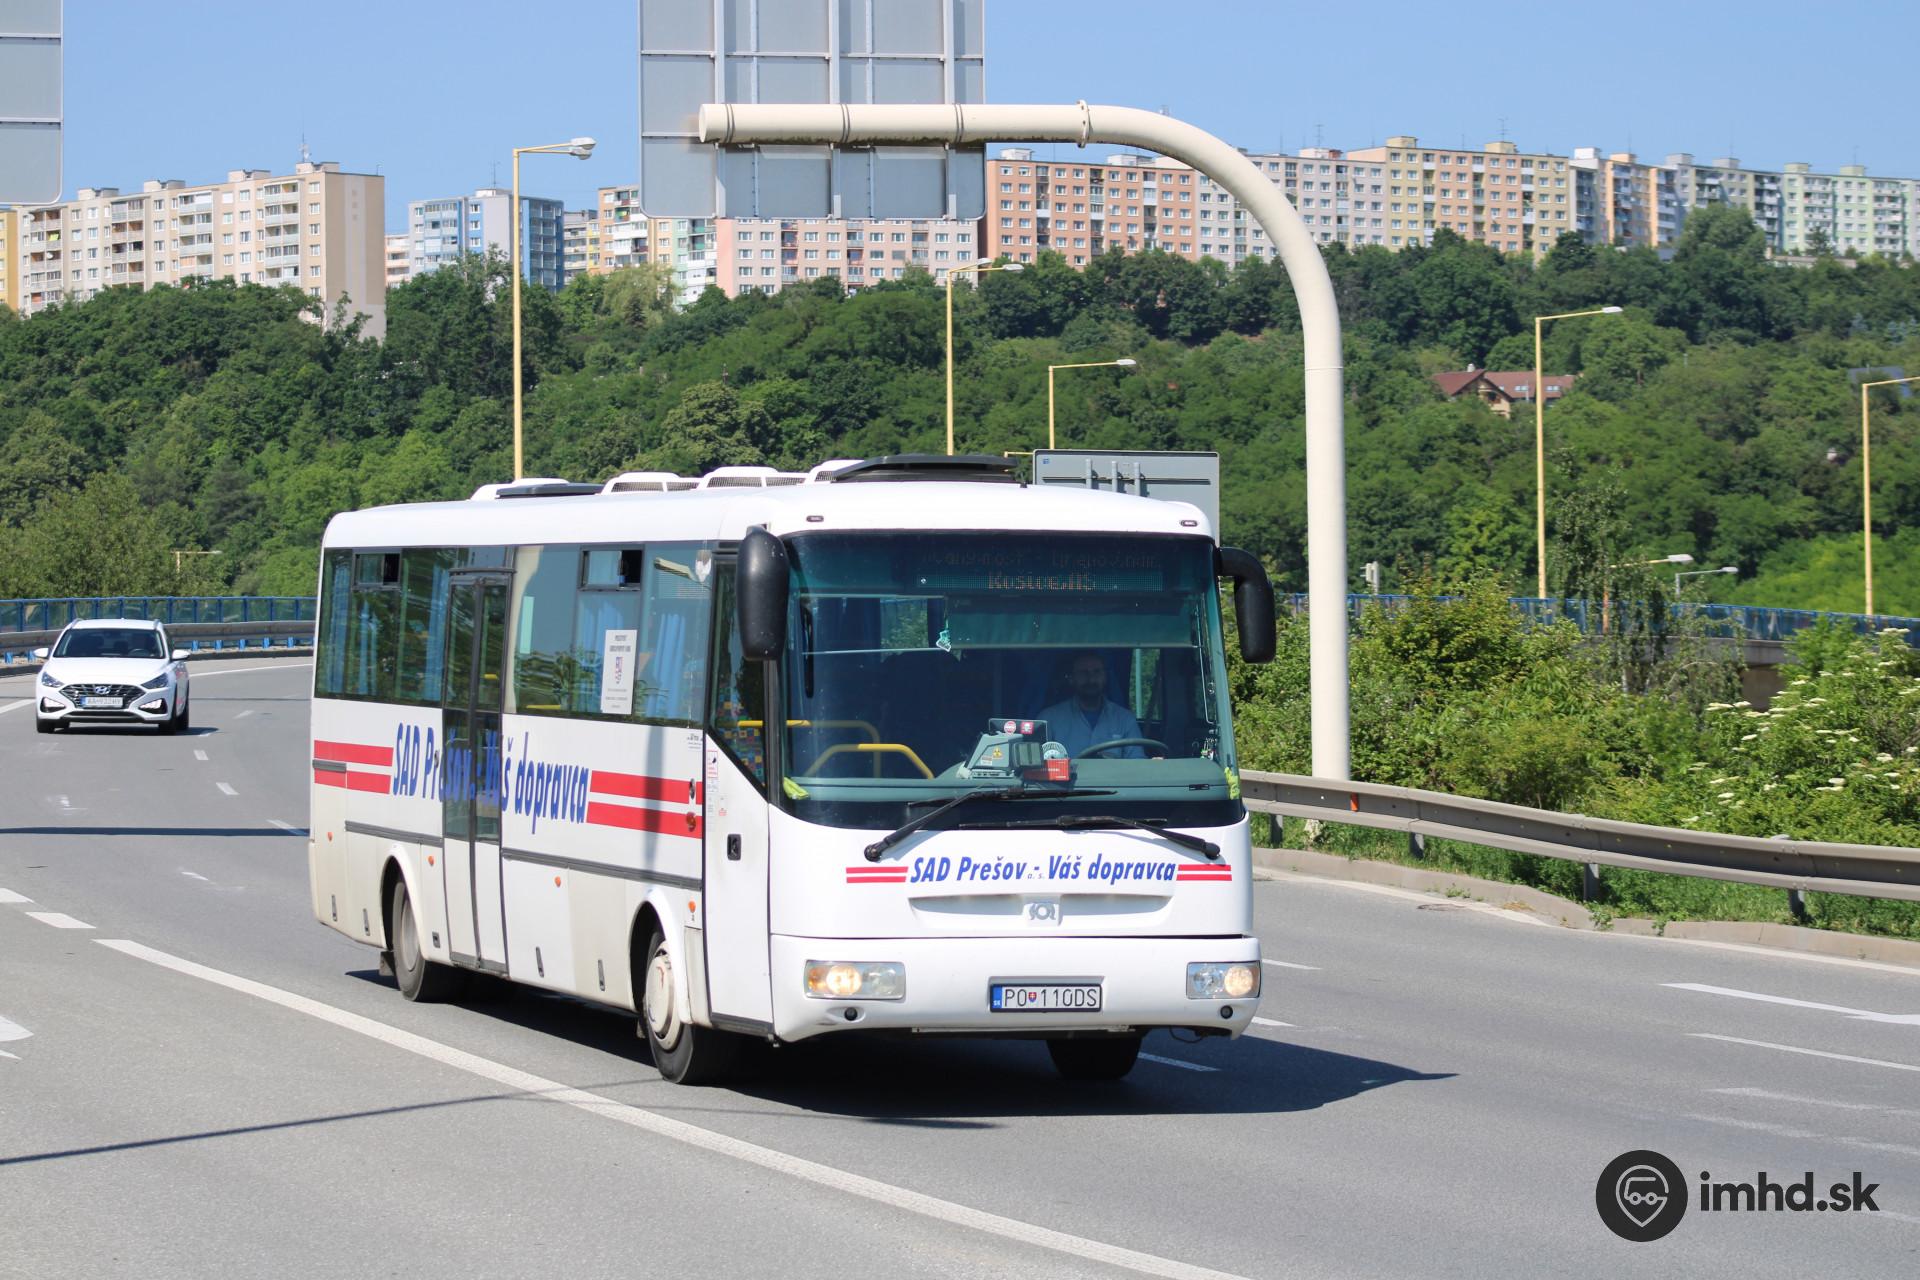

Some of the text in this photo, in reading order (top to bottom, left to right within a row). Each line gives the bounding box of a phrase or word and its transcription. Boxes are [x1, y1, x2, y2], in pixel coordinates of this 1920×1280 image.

[393, 722, 420, 796] SAD
[514, 731, 589, 835] dopravca
[910, 856, 950, 883] SAD
[956, 854, 1027, 881] Prešov
[1049, 855, 1082, 880] Váš
[1088, 853, 1176, 885] dopravca
